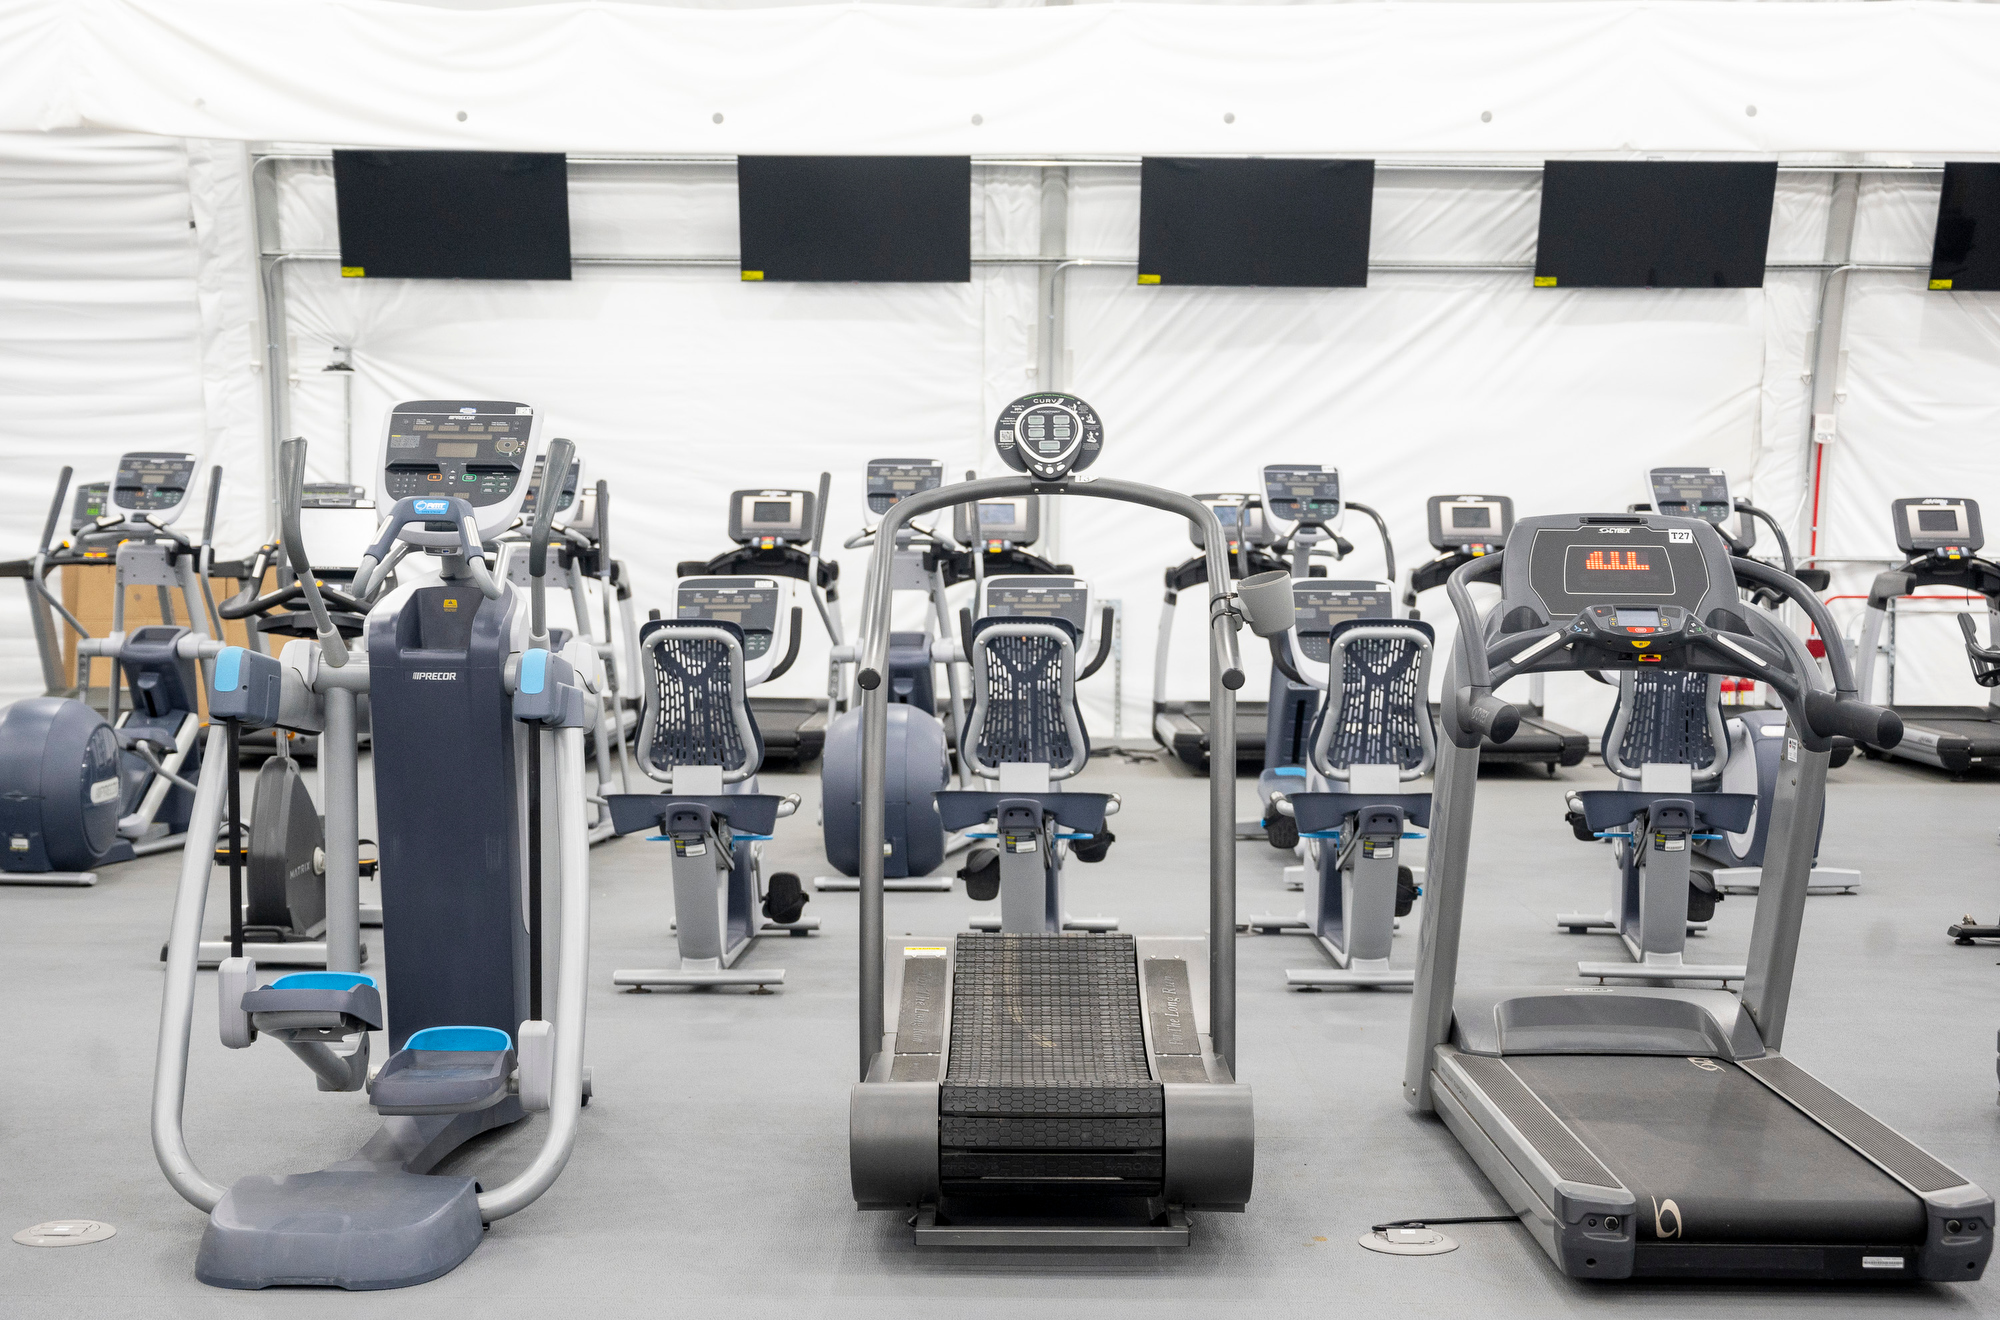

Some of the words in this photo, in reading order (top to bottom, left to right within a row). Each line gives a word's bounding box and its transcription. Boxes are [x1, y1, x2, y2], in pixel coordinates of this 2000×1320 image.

[1671, 532, 1690, 540] T27
[418, 672, 457, 681] PRECOR
[289, 861, 311, 880] MATRIX
[1162, 975, 1177, 995] Run
[1164, 997, 1181, 1017] Long
[1166, 1018, 1182, 1032] The
